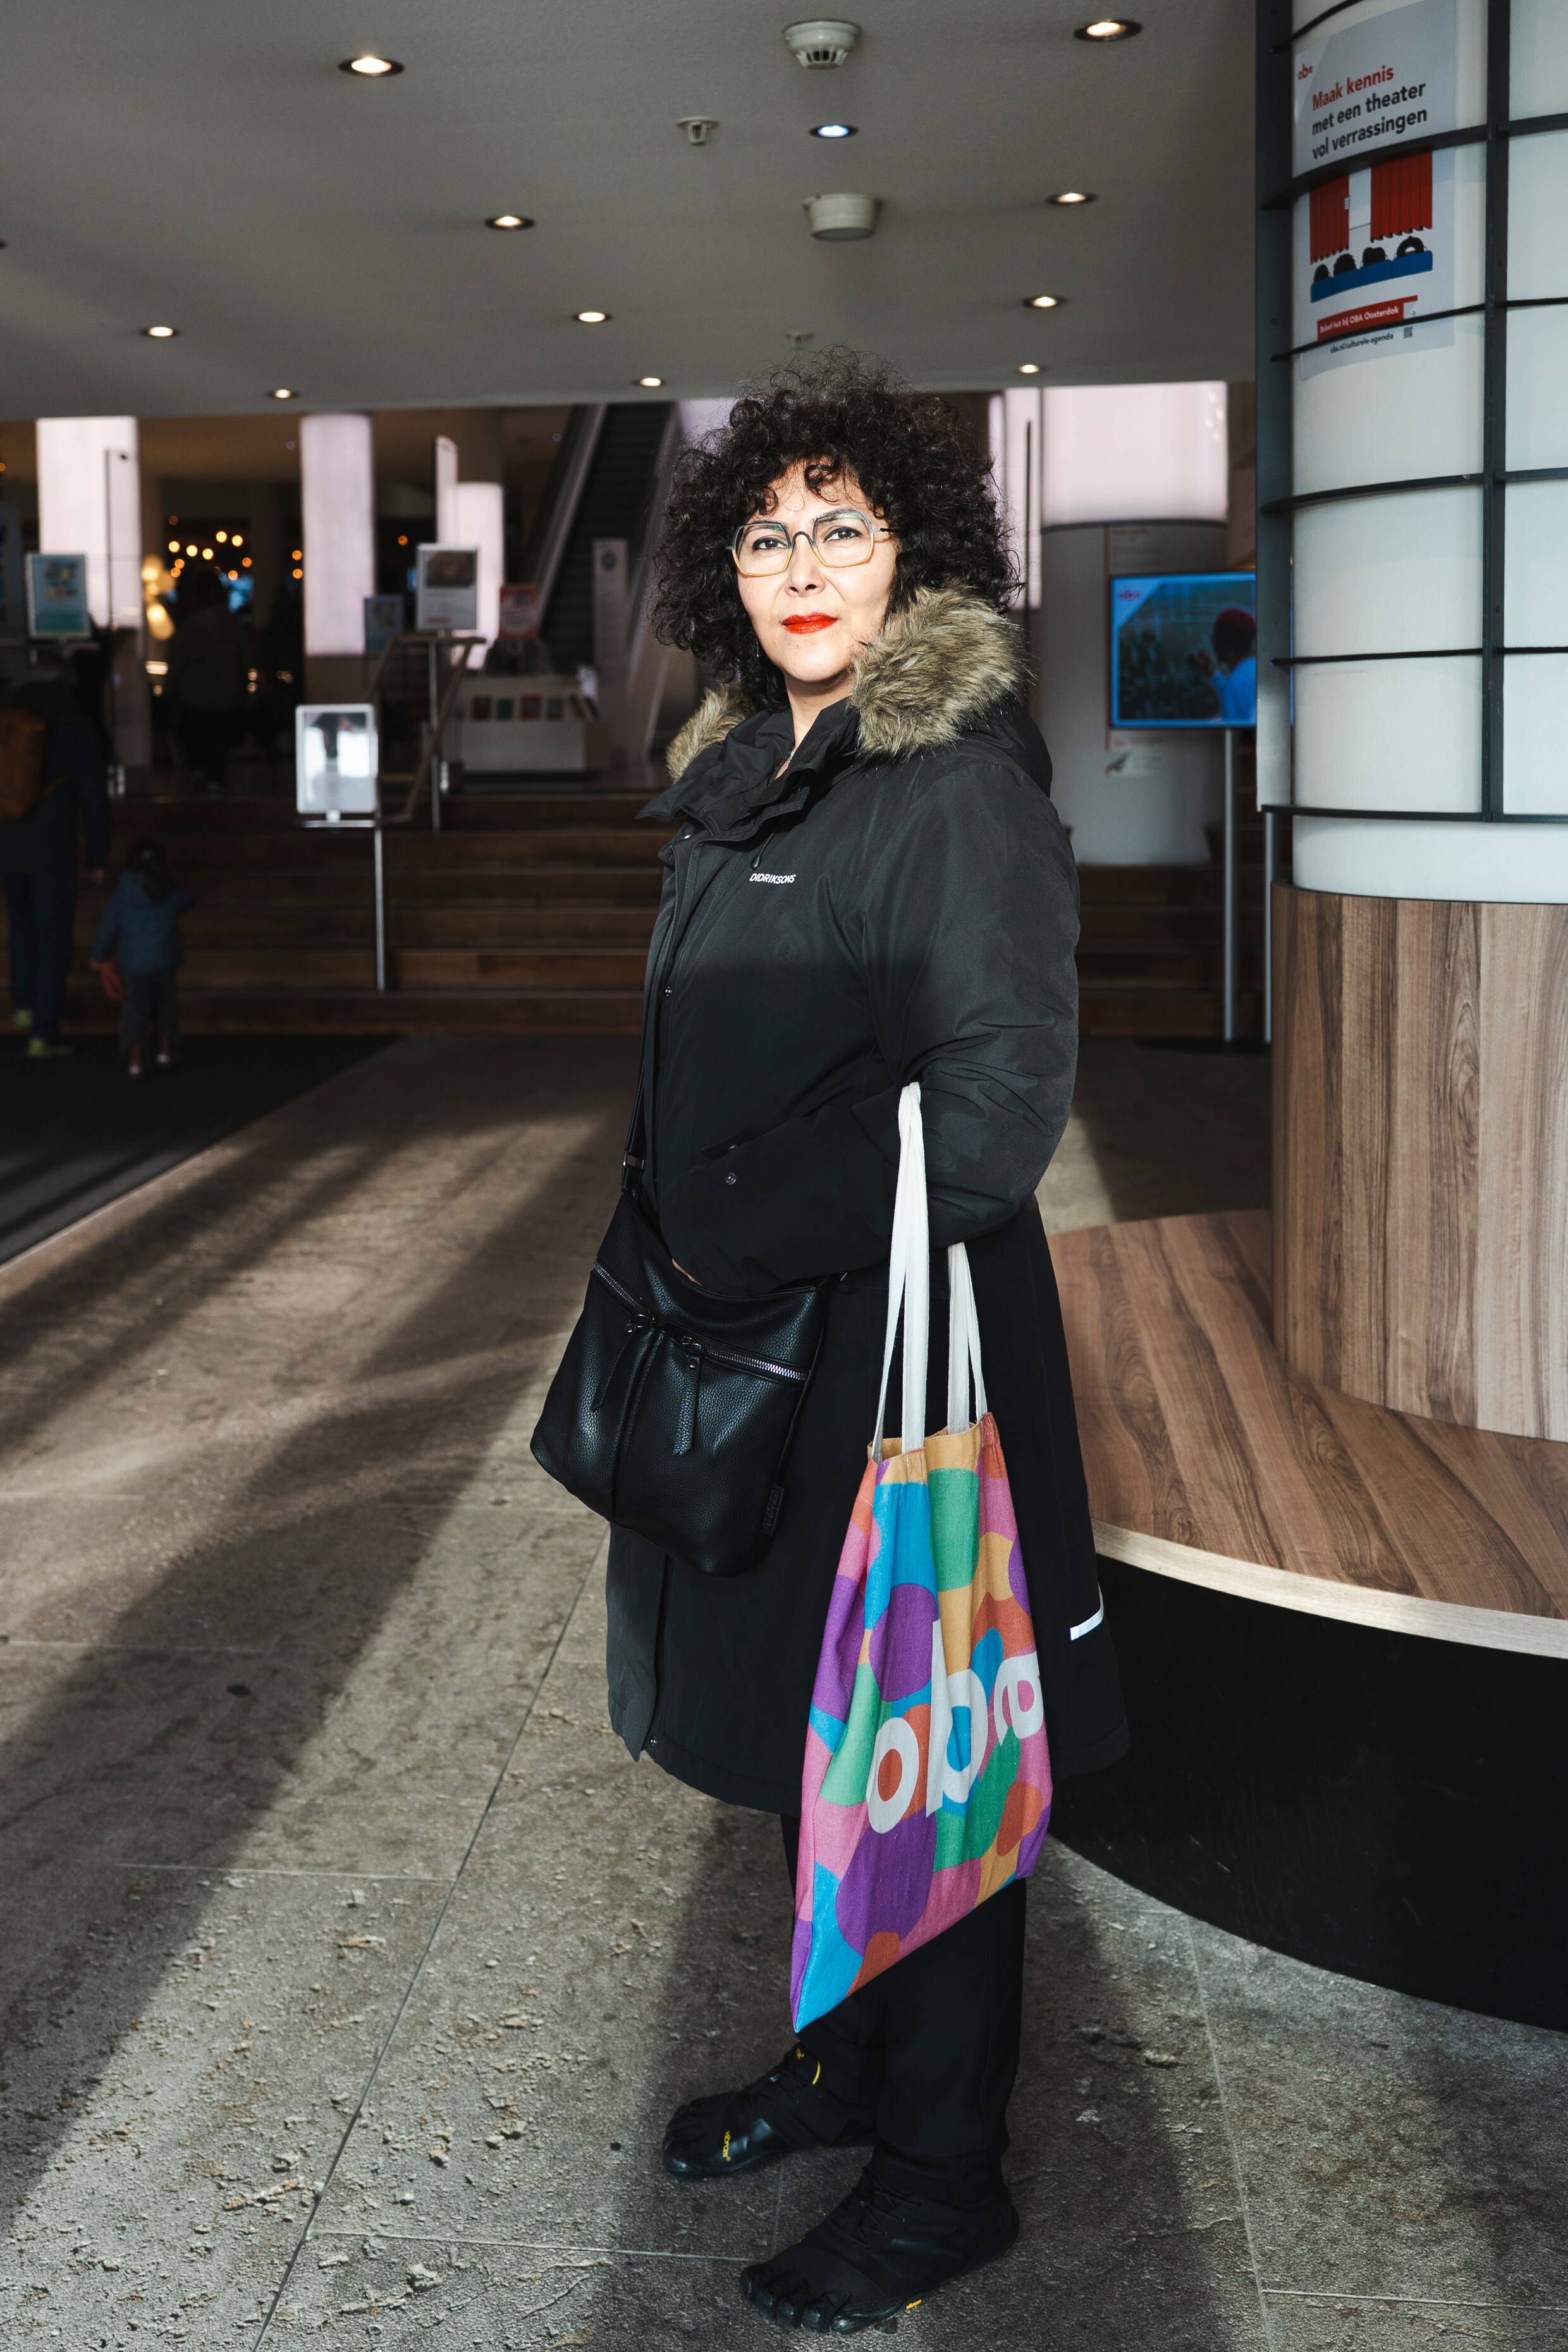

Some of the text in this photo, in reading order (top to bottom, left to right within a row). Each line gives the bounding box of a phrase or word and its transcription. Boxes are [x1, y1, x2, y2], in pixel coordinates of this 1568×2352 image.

[1298, 63, 1313, 80] oba
[1313, 65, 1393, 110] Maak kennis
[1313, 83, 1426, 136] met een theater
[1313, 109, 1427, 159] vol verrassingen
[1349, 315, 1363, 324] OBA
[1364, 306, 1399, 321] Oosterdok
[749, 873, 796, 884] DIDRIKSONS
